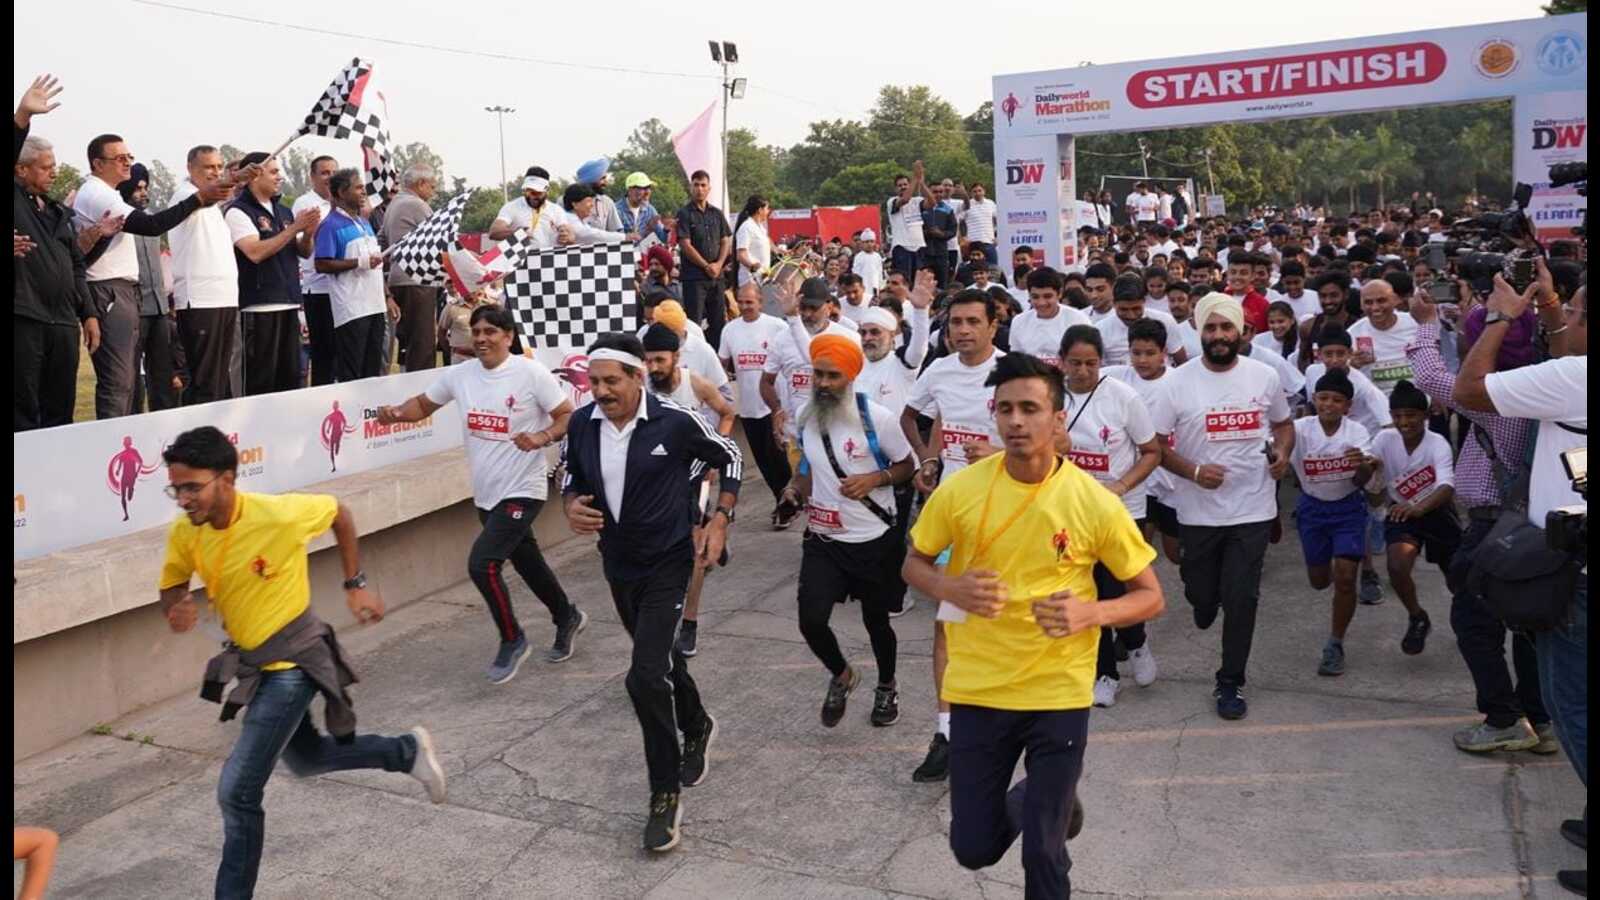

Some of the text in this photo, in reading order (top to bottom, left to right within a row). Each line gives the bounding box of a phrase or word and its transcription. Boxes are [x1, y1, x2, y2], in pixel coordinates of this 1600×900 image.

[1143, 48, 1425, 102] START/FINISH
[1035, 90, 1090, 103] Dailyworld
[1036, 99, 1110, 116] Marathon
[1532, 124, 1586, 150] DW
[1006, 164, 1045, 184] DW
[1220, 412, 1254, 426] 5603
[1407, 470, 1433, 490] 6001
